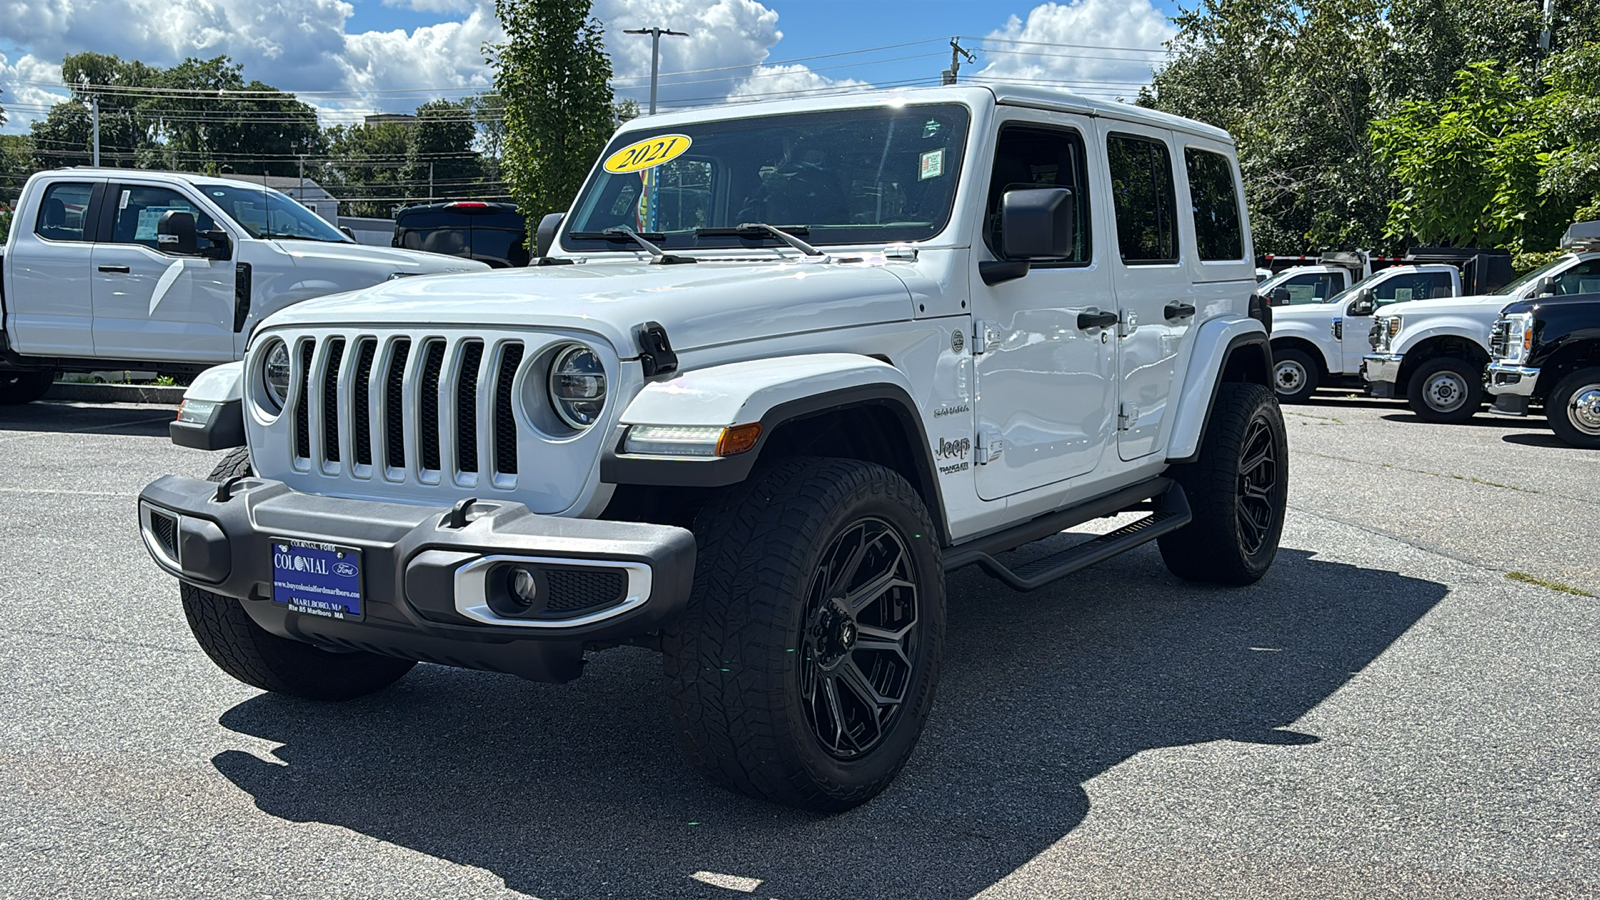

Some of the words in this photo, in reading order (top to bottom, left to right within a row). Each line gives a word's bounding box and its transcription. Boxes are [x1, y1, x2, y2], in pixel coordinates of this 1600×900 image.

[616, 138, 679, 170] 2021
[935, 437, 971, 461] Jeep
[274, 553, 329, 575] COLONIAL
[336, 563, 354, 575] Ford
[307, 606, 332, 618] Marlboro
[334, 611, 344, 619] MA
